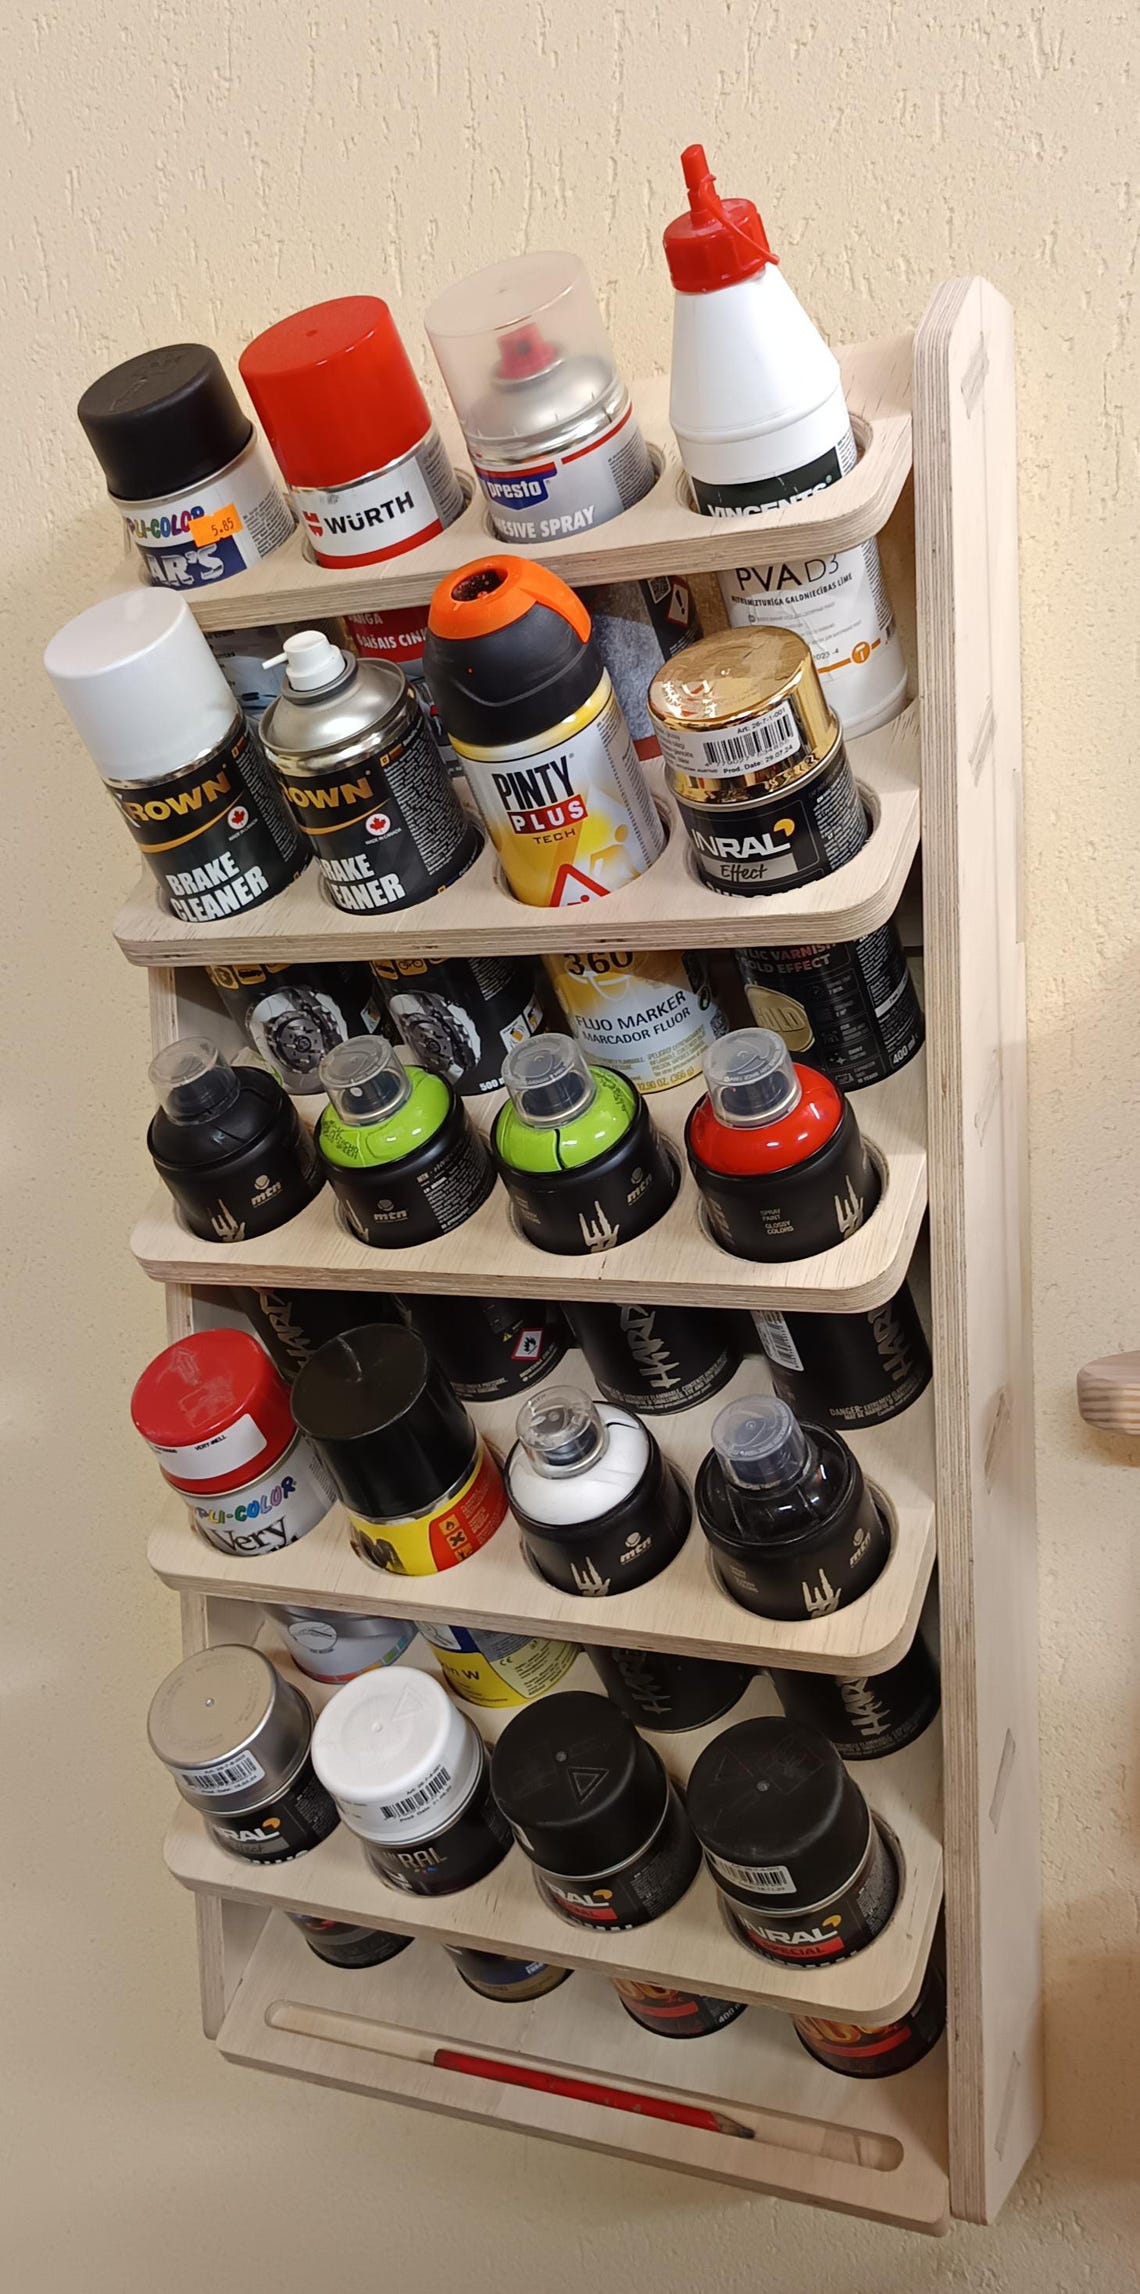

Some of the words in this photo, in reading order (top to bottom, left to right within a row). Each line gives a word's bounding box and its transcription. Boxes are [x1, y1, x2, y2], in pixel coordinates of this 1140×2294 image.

[486, 480, 543, 498] presto
[211, 517, 234, 537] 5.85
[323, 491, 415, 535] WÜRTH
[540, 505, 595, 537] SPRAY
[735, 564, 802, 592] PVA
[804, 554, 840, 583] D3
[491, 754, 575, 811] PINTY
[723, 766, 742, 774] Prod.
[744, 761, 763, 770] Date:
[124, 771, 231, 821] ROWN
[279, 777, 374, 809] OWN
[511, 800, 584, 832] PLUS
[533, 827, 577, 845] TECH
[165, 851, 240, 896] BRAKE
[720, 863, 768, 883] Effect
[170, 865, 270, 922] CLEANER
[563, 951, 634, 976] 360
[770, 944, 836, 961] VARNIS
[776, 953, 831, 974] EFFECT
[576, 1015, 613, 1032] FLUO
[617, 990, 687, 1030] MARKER
[582, 1027, 651, 1046] MARCADOR
[653, 1006, 692, 1035] FLUOR
[893, 1045, 908, 1064] 400
[479, 1078, 499, 1091] 500
[209, 1515, 287, 1552] Very
